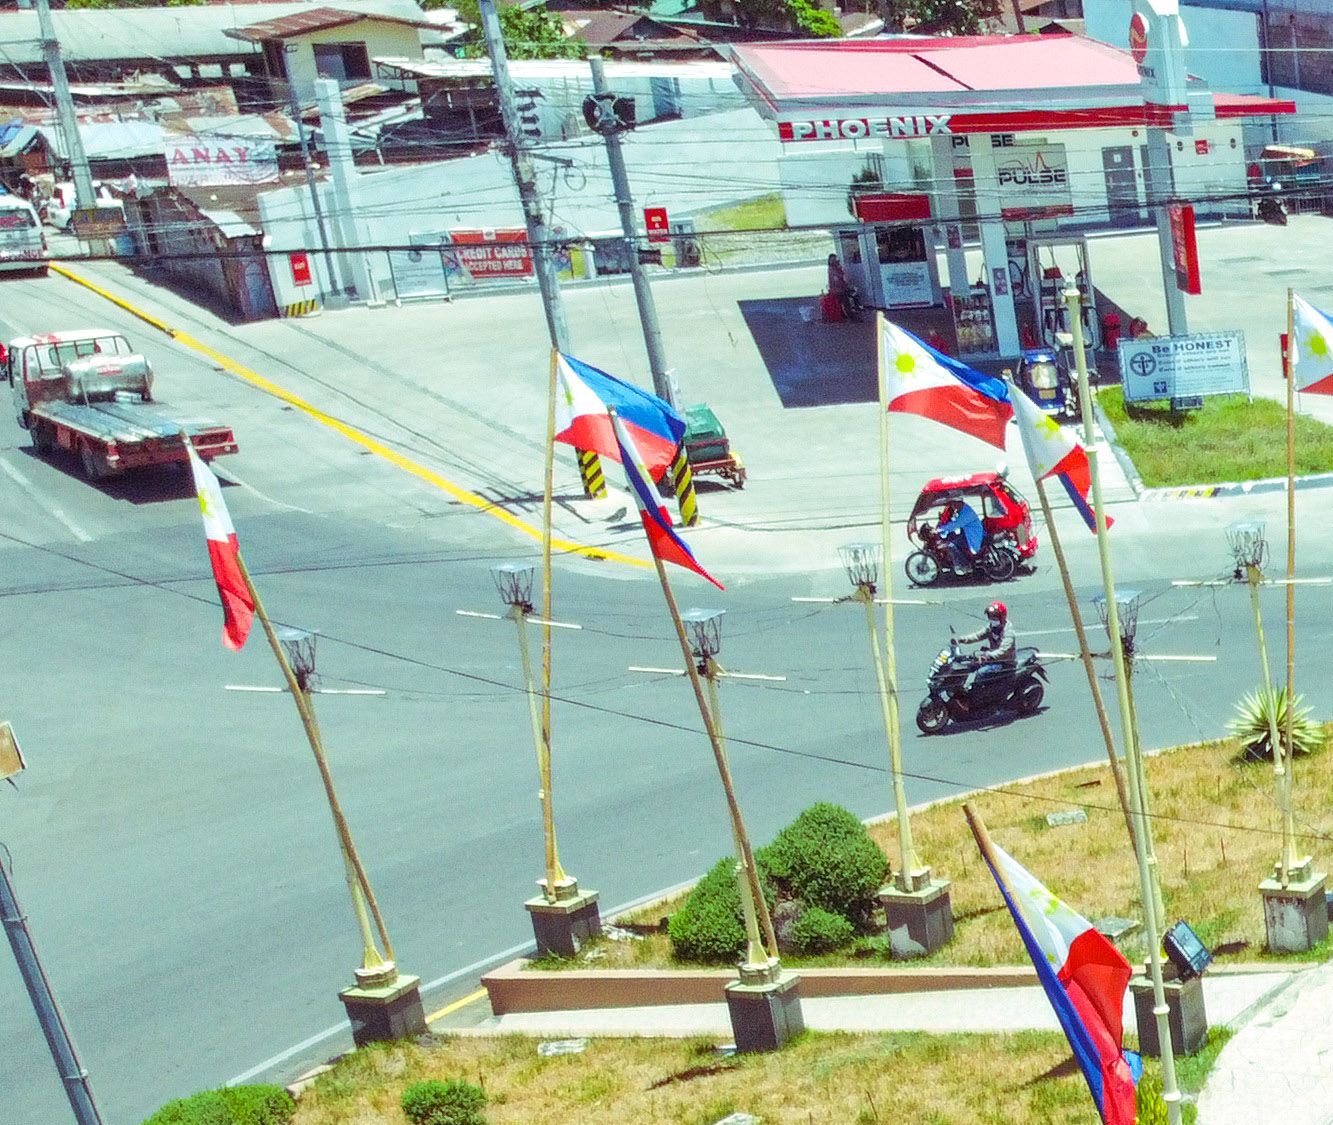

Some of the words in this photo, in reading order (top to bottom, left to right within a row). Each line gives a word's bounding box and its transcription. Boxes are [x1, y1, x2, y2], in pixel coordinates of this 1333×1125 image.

[792, 115, 952, 141] PHOENIX
[172, 147, 250, 164] ANAY
[998, 168, 1067, 186] PULSE
[456, 246, 492, 259] CREDIT
[494, 245, 528, 258] CARDS
[1152, 345, 1171, 354] Be
[1174, 339, 1232, 352] HONEST
